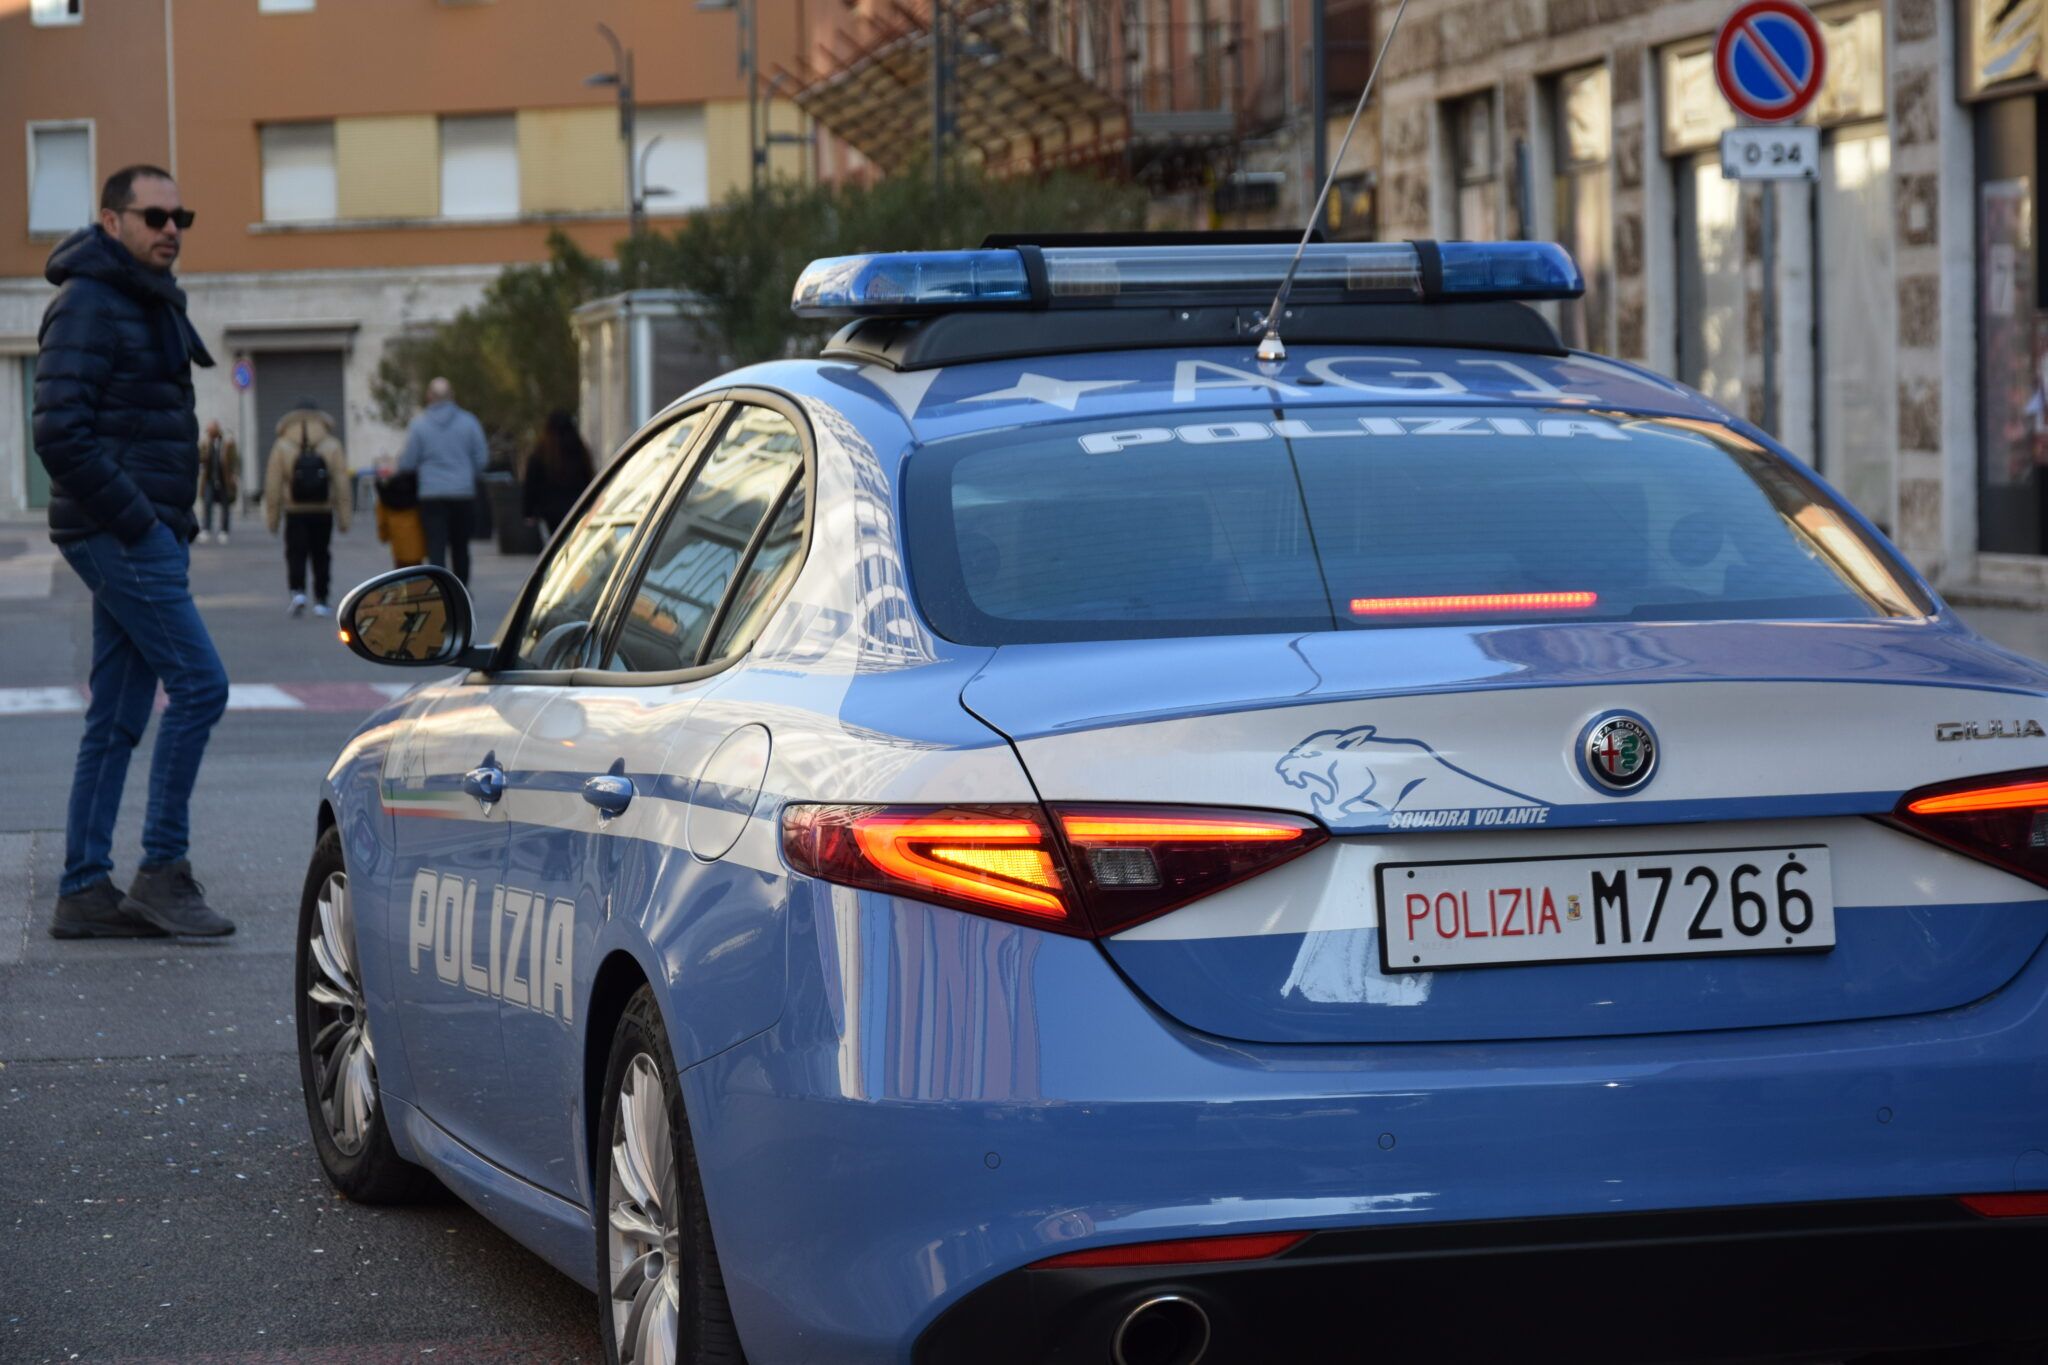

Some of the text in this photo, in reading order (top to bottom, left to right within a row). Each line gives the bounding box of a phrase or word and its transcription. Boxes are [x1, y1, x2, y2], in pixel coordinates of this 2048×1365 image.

[1078, 416, 1632, 455] POLIZIA
[1592, 721, 1652, 753] ALFA ROMEO
[1935, 719, 2046, 742] GIULIA
[1387, 806, 1550, 829] SQUADRA VOLANTE
[1406, 861, 1815, 945] POLIZIA M7266
[408, 868, 575, 1026] POLIZIA
